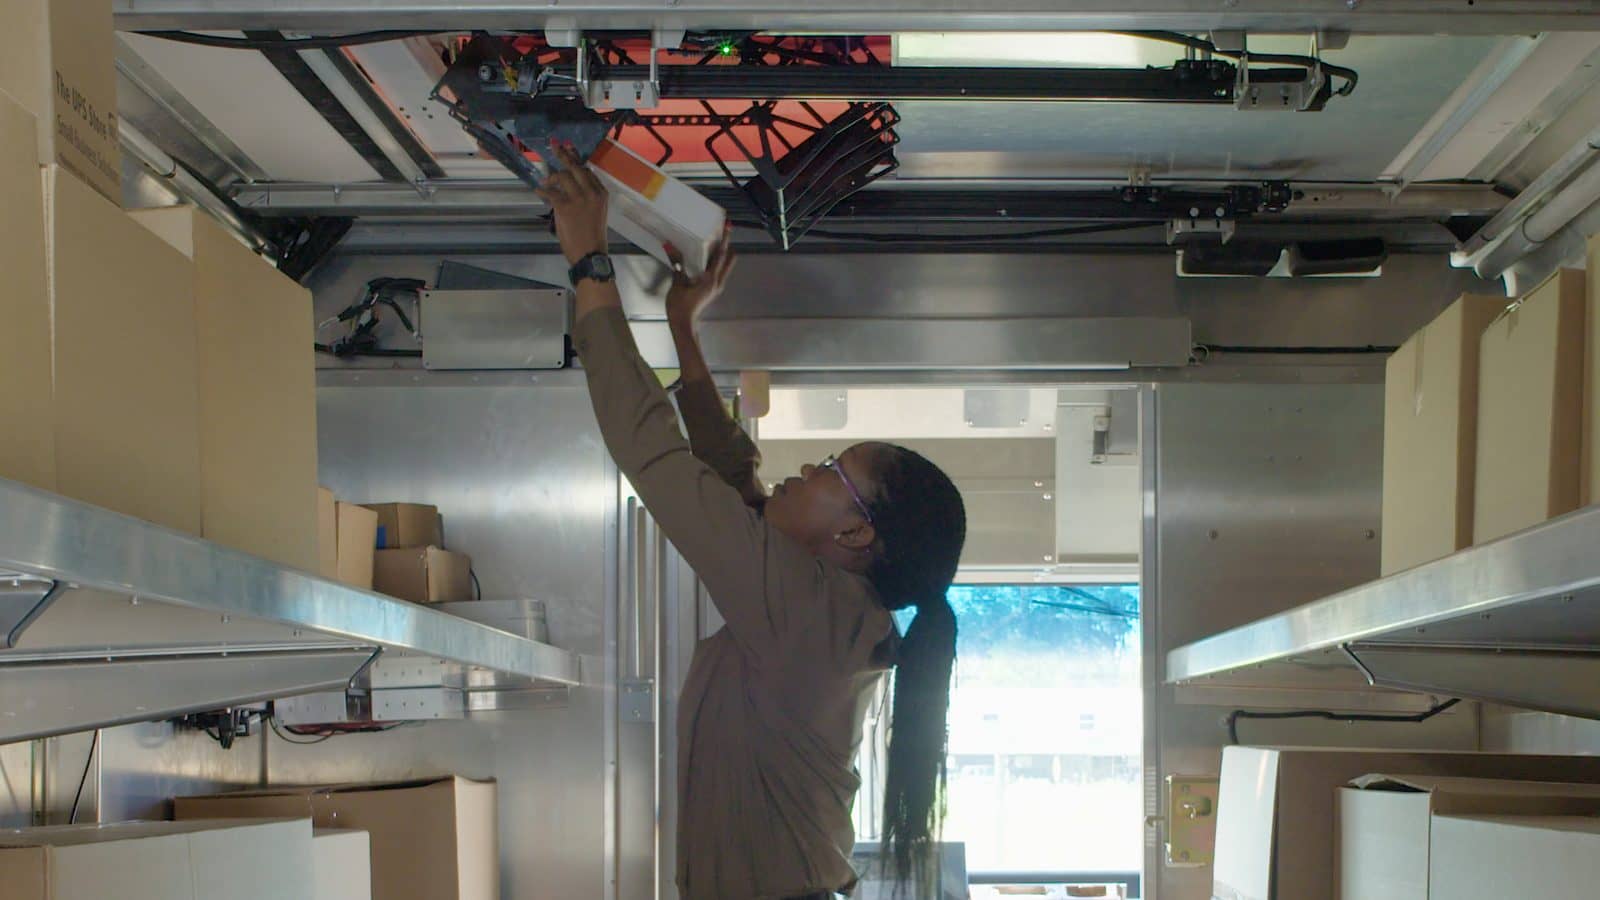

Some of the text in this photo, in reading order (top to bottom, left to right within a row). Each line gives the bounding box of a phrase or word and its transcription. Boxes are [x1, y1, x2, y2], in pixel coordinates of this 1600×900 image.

[55, 70, 71, 105] The
[72, 87, 87, 121] UPS
[88, 103, 107, 140] Store
